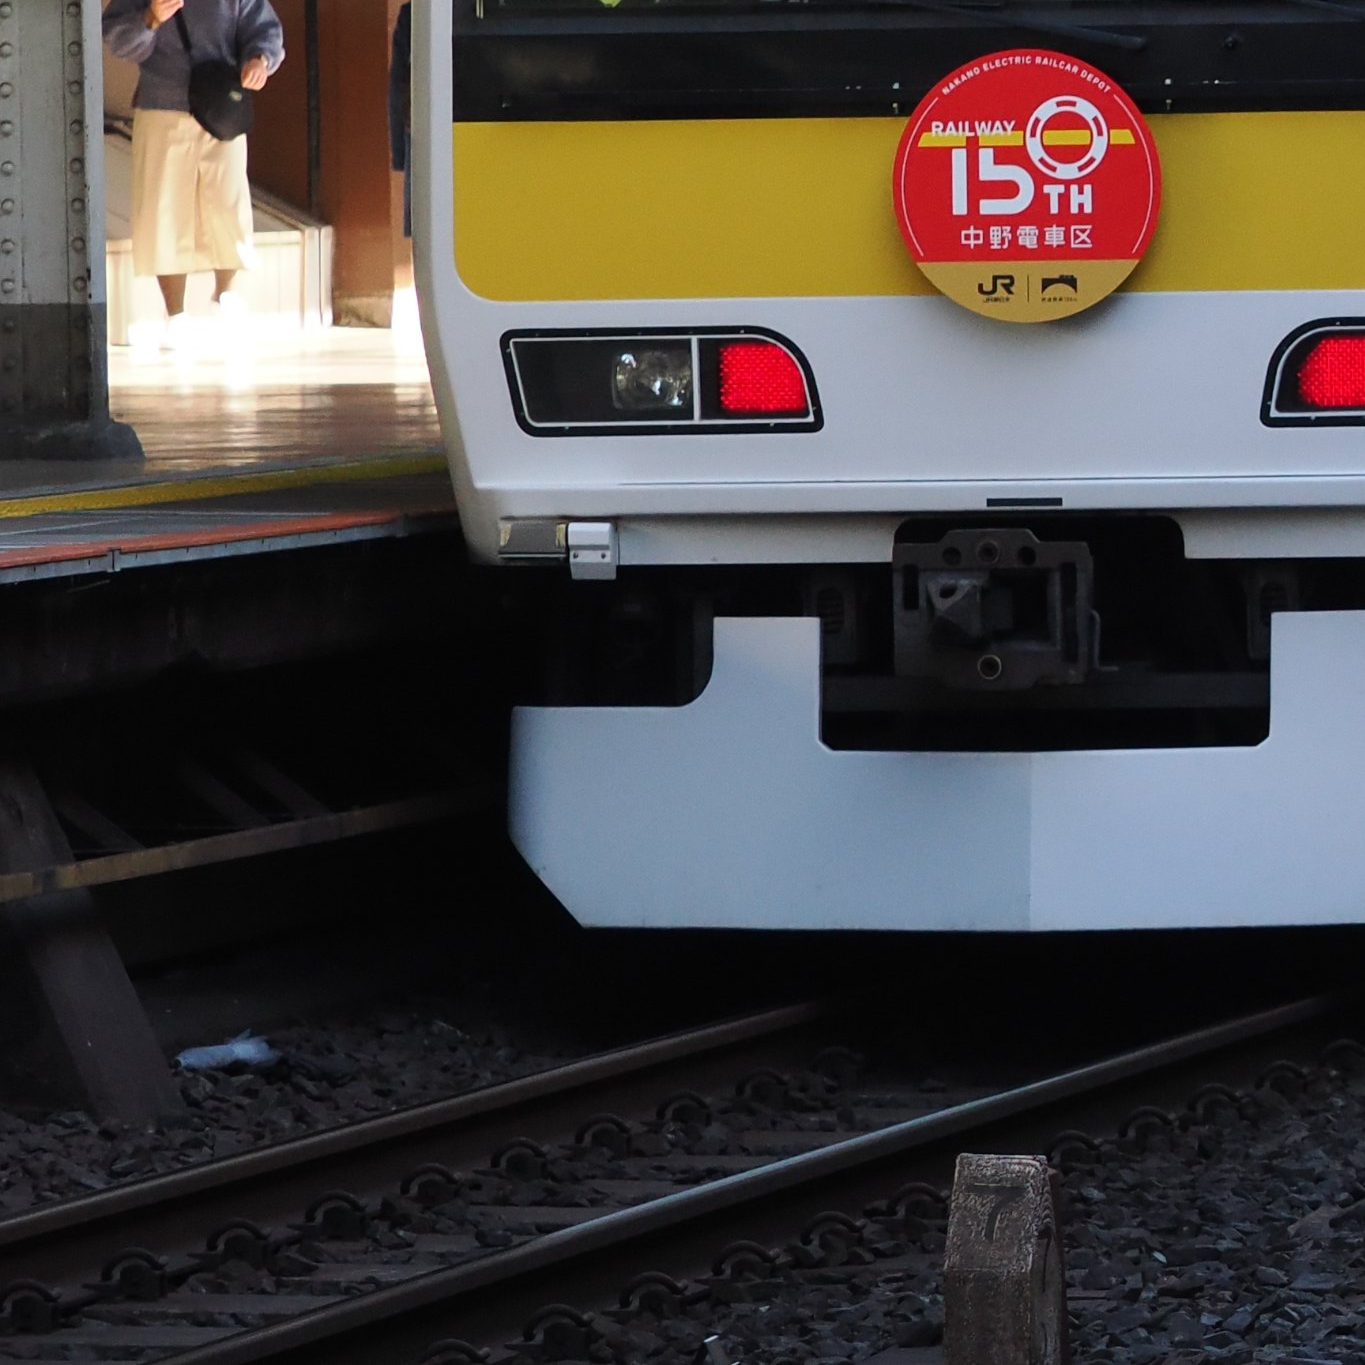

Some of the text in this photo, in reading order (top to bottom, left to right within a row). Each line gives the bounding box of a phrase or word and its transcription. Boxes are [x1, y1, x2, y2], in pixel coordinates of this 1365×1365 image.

[942, 55, 1111, 96] NAKANO ELECTRIC RAILCAR DEPOT
[931, 120, 1016, 137] RAILWAY
[960, 224, 1094, 250] 中野電車区
[977, 274, 1015, 295] JR
